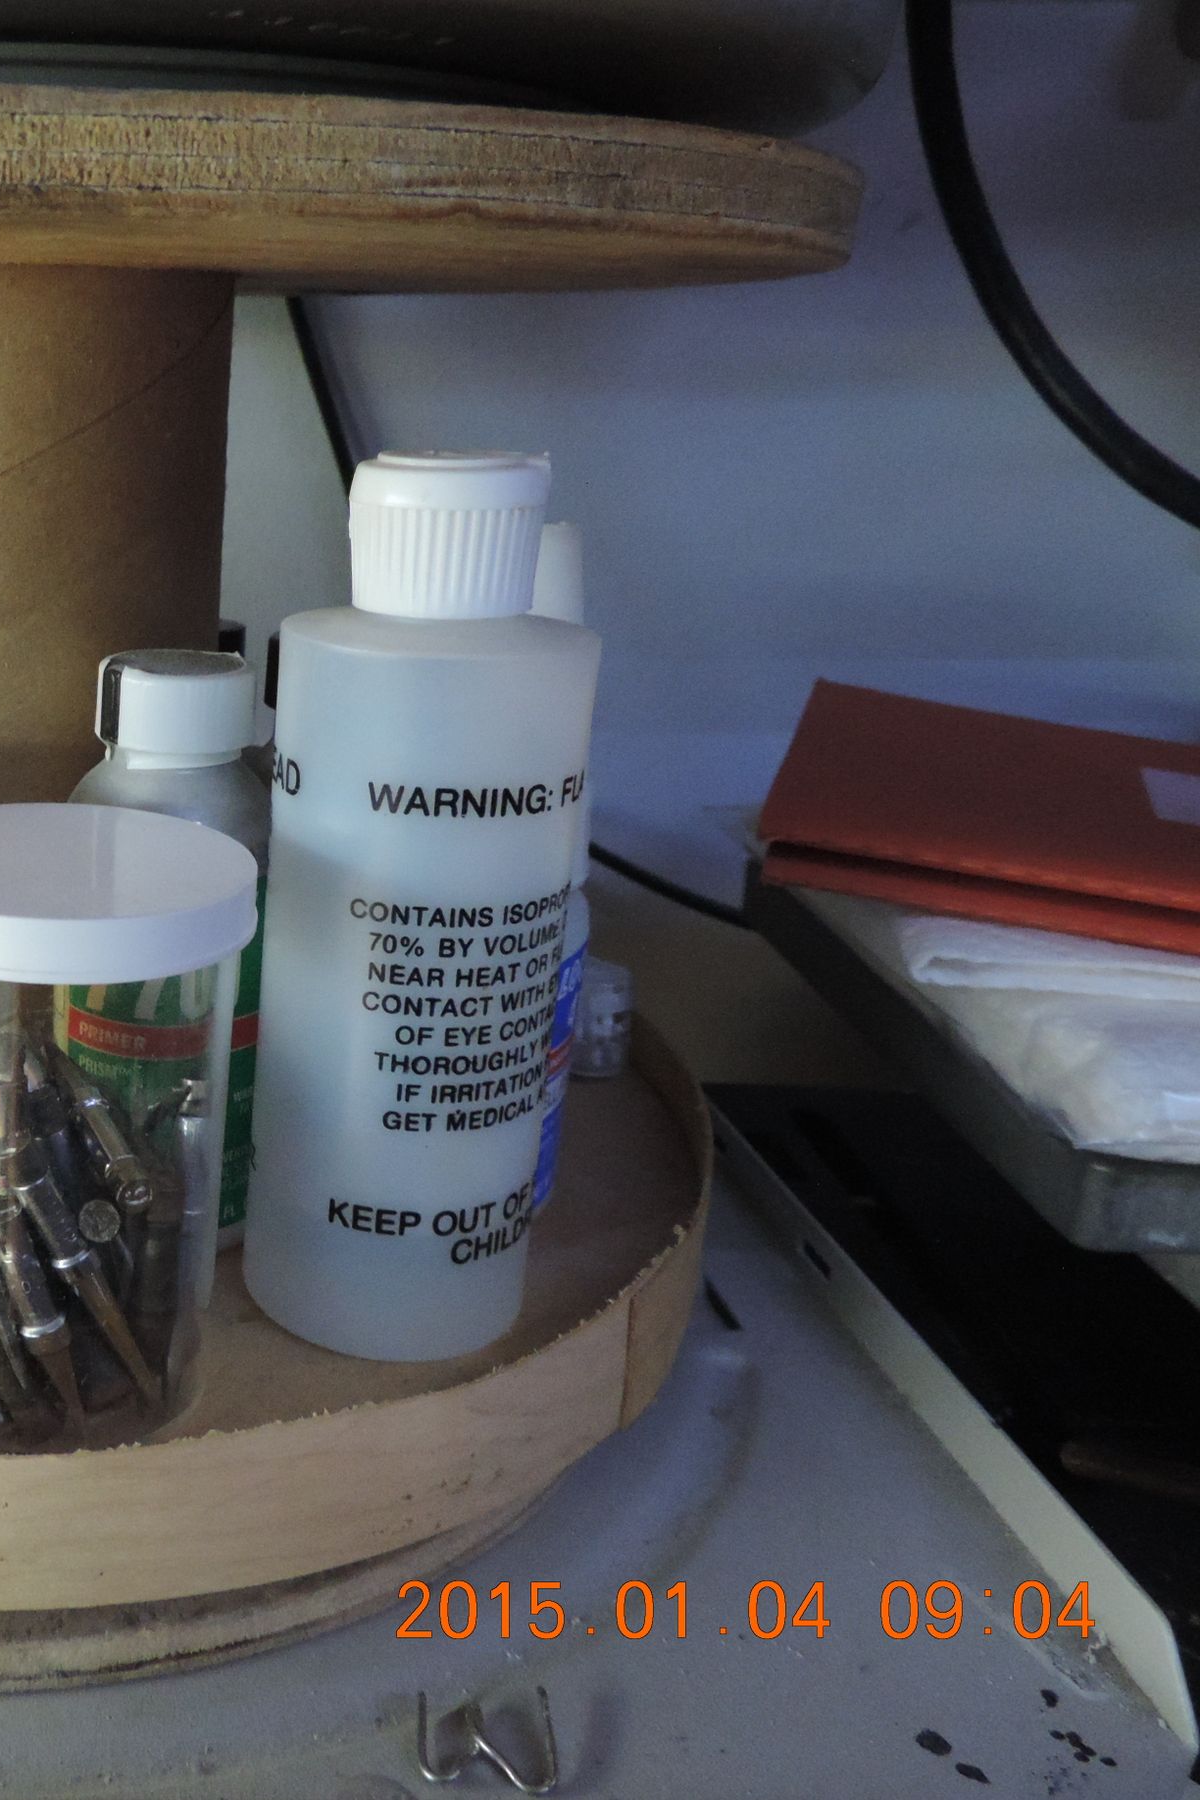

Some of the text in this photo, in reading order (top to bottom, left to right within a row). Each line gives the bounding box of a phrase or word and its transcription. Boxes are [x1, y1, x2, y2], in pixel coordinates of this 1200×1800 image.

[368, 781, 553, 818] WARNING:
[350, 898, 493, 928] CONTAINS
[369, 932, 424, 957] 70%
[438, 938, 474, 958] BY
[484, 918, 561, 957] VOLUME
[368, 962, 444, 988] NEAR
[455, 963, 520, 988] HEAT
[526, 954, 548, 979] OR
[362, 991, 493, 1018] CONTACT
[501, 982, 545, 1013] WITH
[79, 1021, 146, 1050] PRIMER
[395, 1025, 434, 1046] OF
[444, 1025, 492, 1047] EYE
[374, 1038, 537, 1076] THOROUGHLY
[396, 1083, 421, 1102] IF
[431, 1061, 542, 1104] IRRITATION
[382, 1110, 437, 1132] GET
[446, 1094, 533, 1132] MEDICAL
[328, 1197, 421, 1236] KEEP
[432, 1202, 497, 1236] OUT
[503, 1182, 530, 1221] OF
